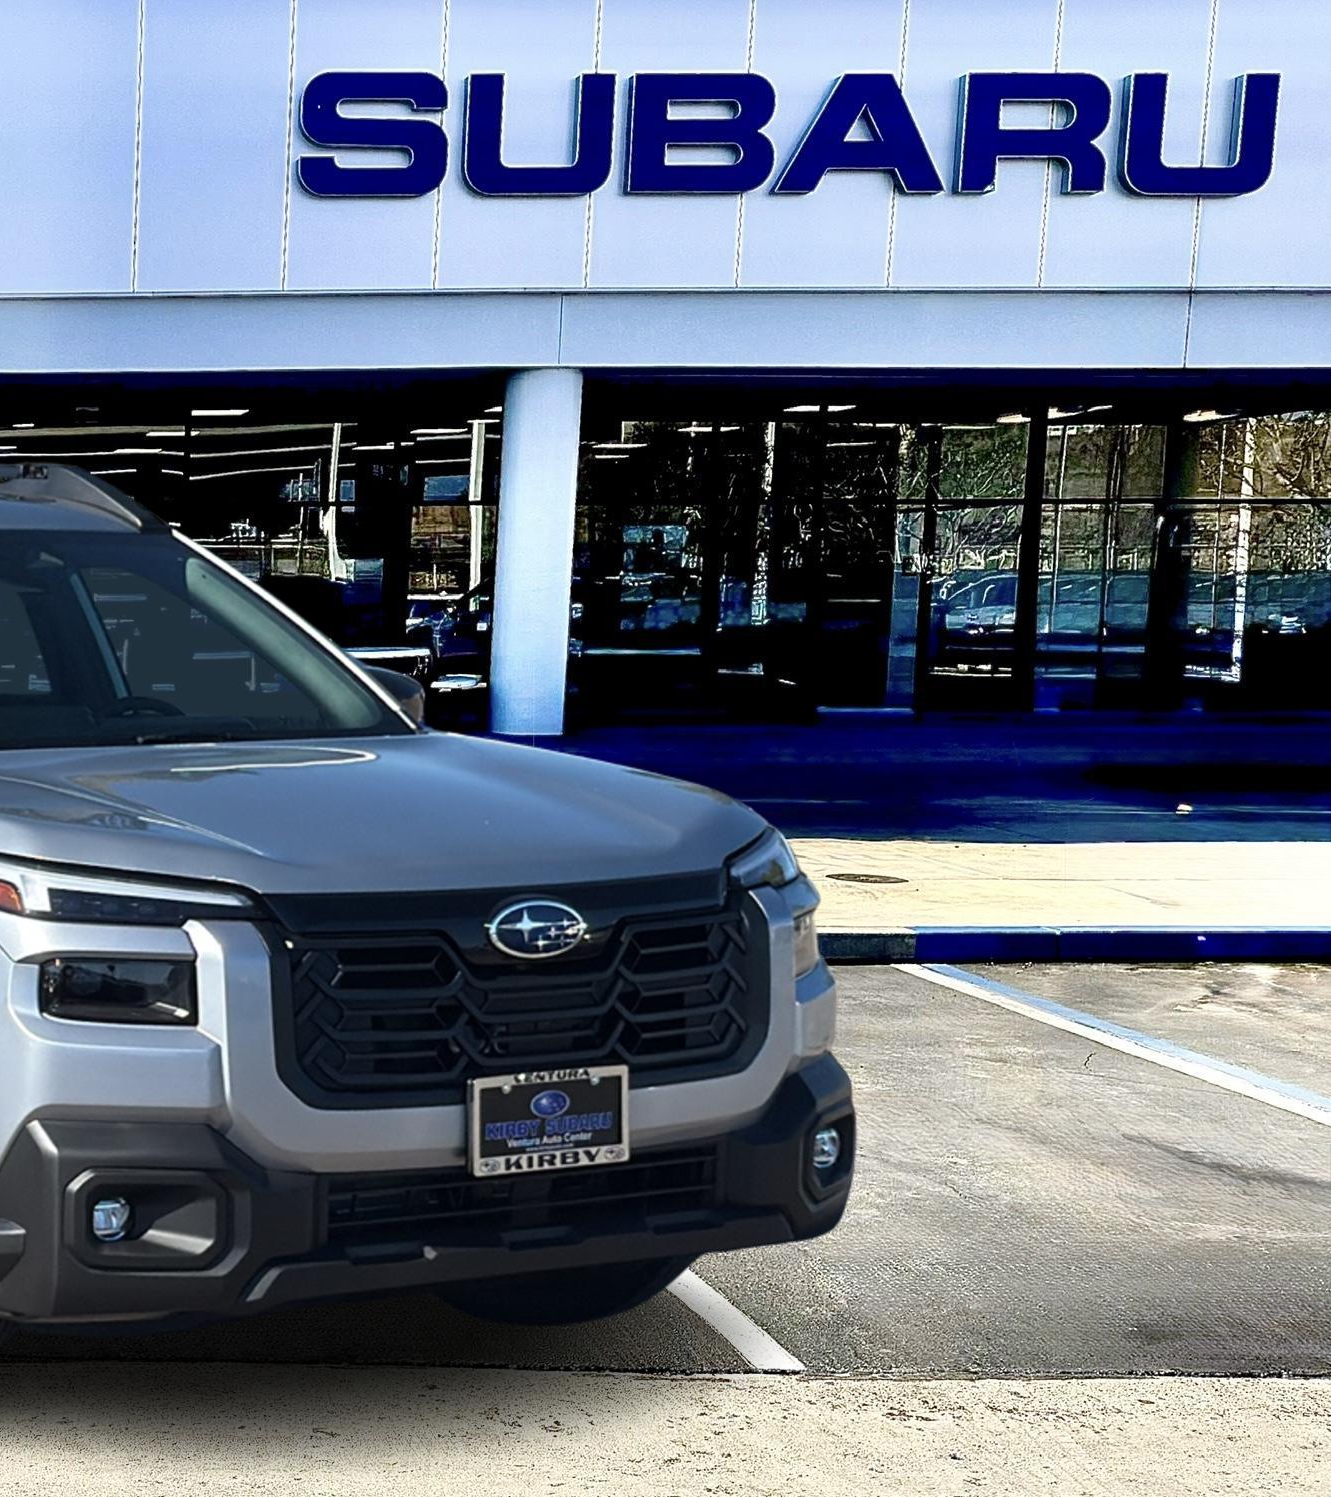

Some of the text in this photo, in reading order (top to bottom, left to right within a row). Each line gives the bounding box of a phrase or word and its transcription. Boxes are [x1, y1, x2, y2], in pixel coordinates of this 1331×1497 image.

[296, 71, 1281, 198] SUBARU
[485, 1111, 613, 1140] KIRBY SUBARU
[506, 1137, 541, 1148] Ventura
[542, 1134, 563, 1145] Auto
[563, 1131, 593, 1142] Center
[504, 1148, 601, 1171] KIRBY
